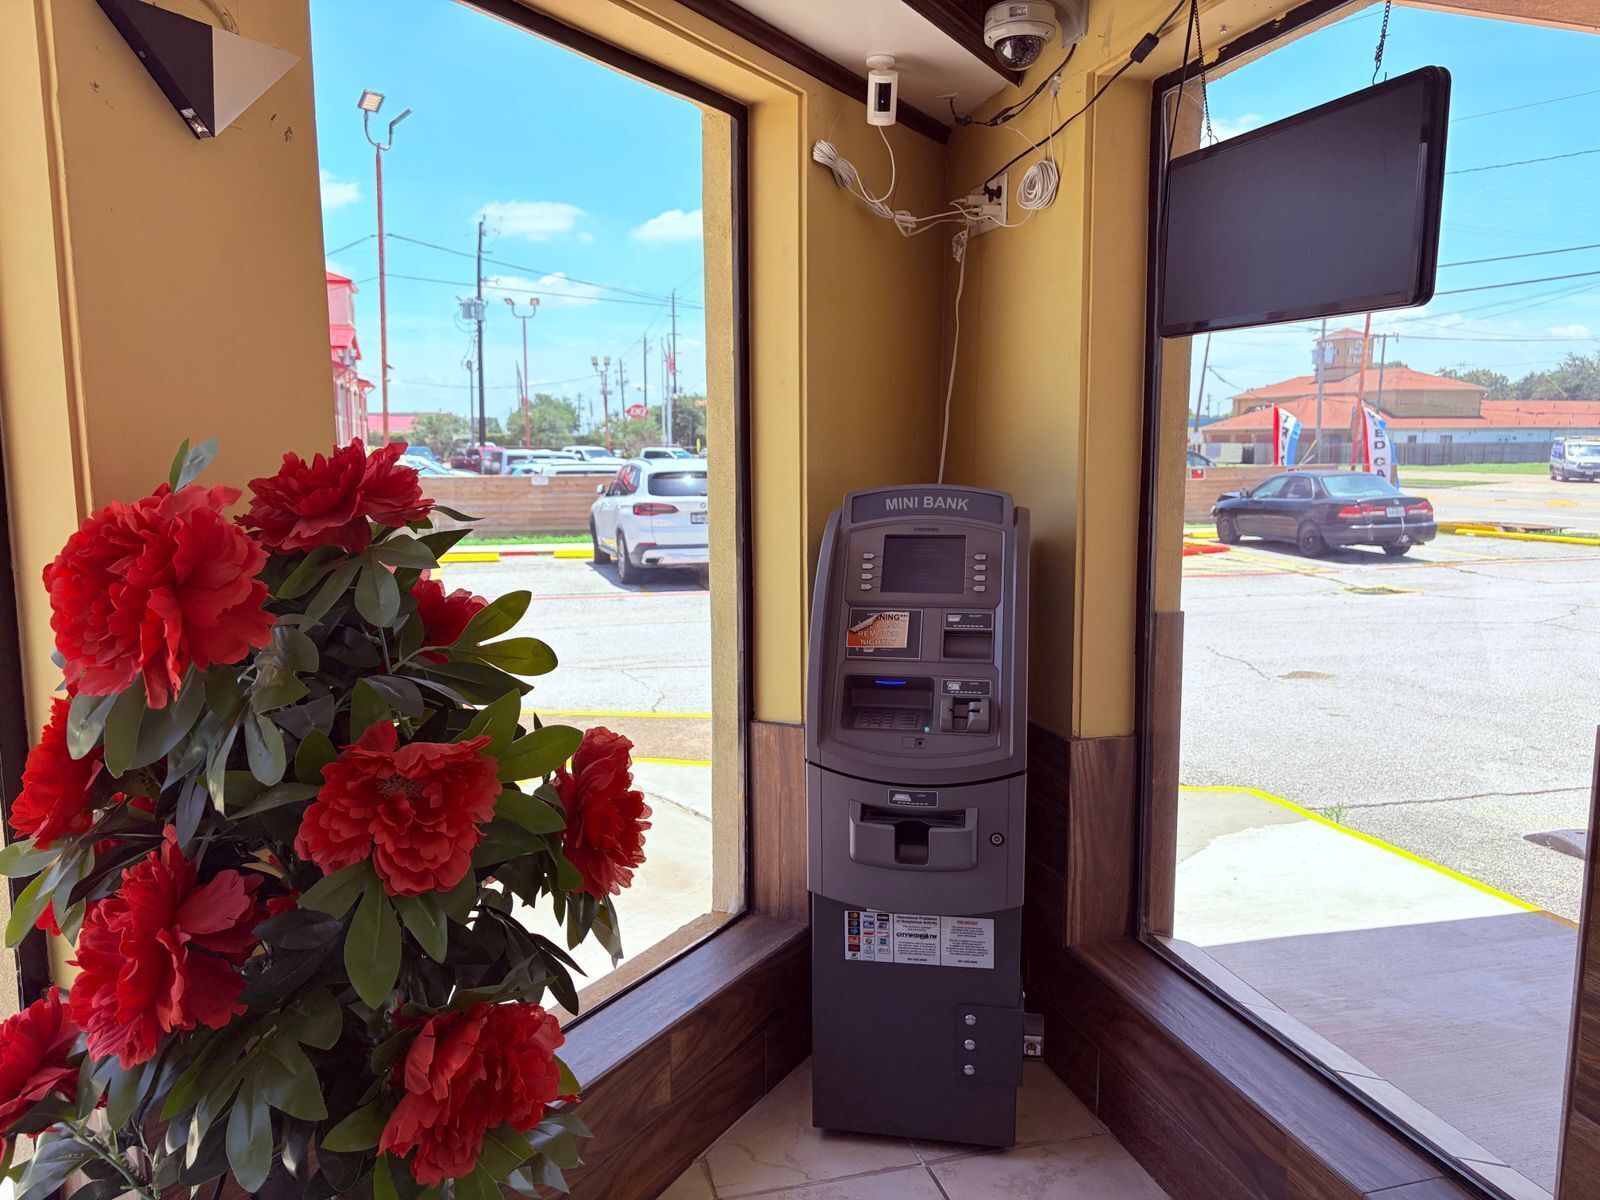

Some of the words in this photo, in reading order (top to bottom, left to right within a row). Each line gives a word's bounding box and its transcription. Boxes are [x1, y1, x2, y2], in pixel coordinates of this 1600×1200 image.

[630, 407, 647, 416] DQ
[885, 496, 918, 511] MINI
[923, 496, 969, 511] BANK
